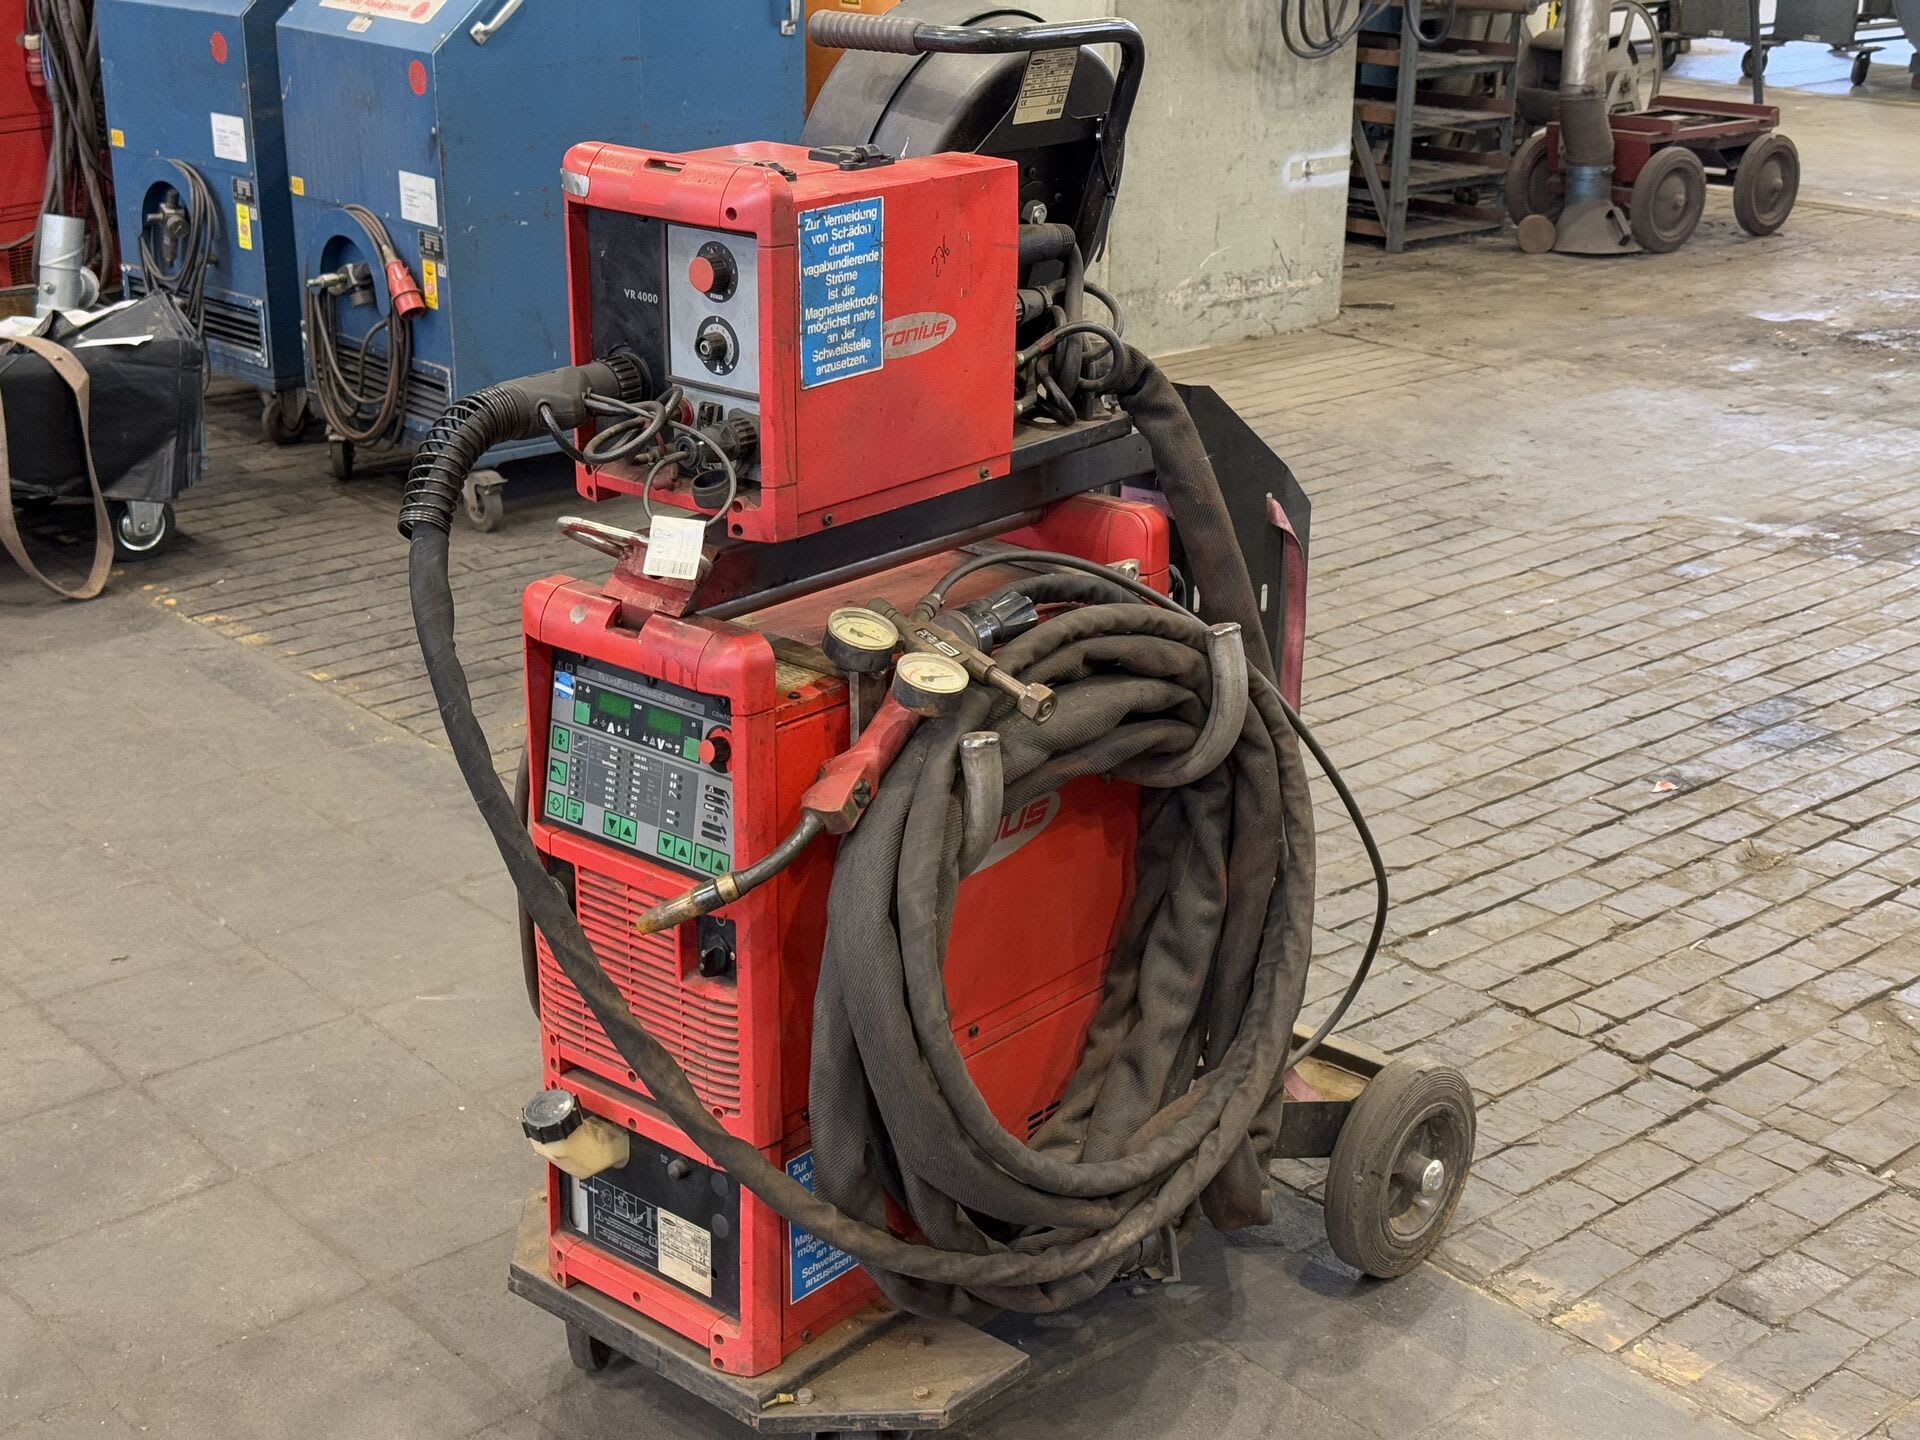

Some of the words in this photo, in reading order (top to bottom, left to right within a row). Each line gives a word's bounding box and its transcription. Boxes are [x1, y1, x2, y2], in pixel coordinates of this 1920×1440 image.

[804, 218, 820, 232] Zur
[823, 207, 877, 228] Vermeidung
[811, 232, 828, 245] von
[828, 241, 854, 256] durch
[803, 250, 879, 278] vagabundierende
[825, 269, 858, 286] Ströme
[624, 288, 636, 300] VR
[637, 289, 659, 304] 4000
[828, 289, 839, 300] ist
[841, 285, 855, 298] die
[805, 294, 878, 321] Magnetelektrode
[807, 314, 851, 335] möglichst
[853, 308, 875, 324] nahe
[827, 332, 838, 344] an
[841, 327, 855, 341] der
[883, 319, 949, 347] ronius
[812, 337, 872, 362] Schweißstelle
[815, 354, 868, 376] anzusetzen.
[793, 1160, 807, 1175] Zur
